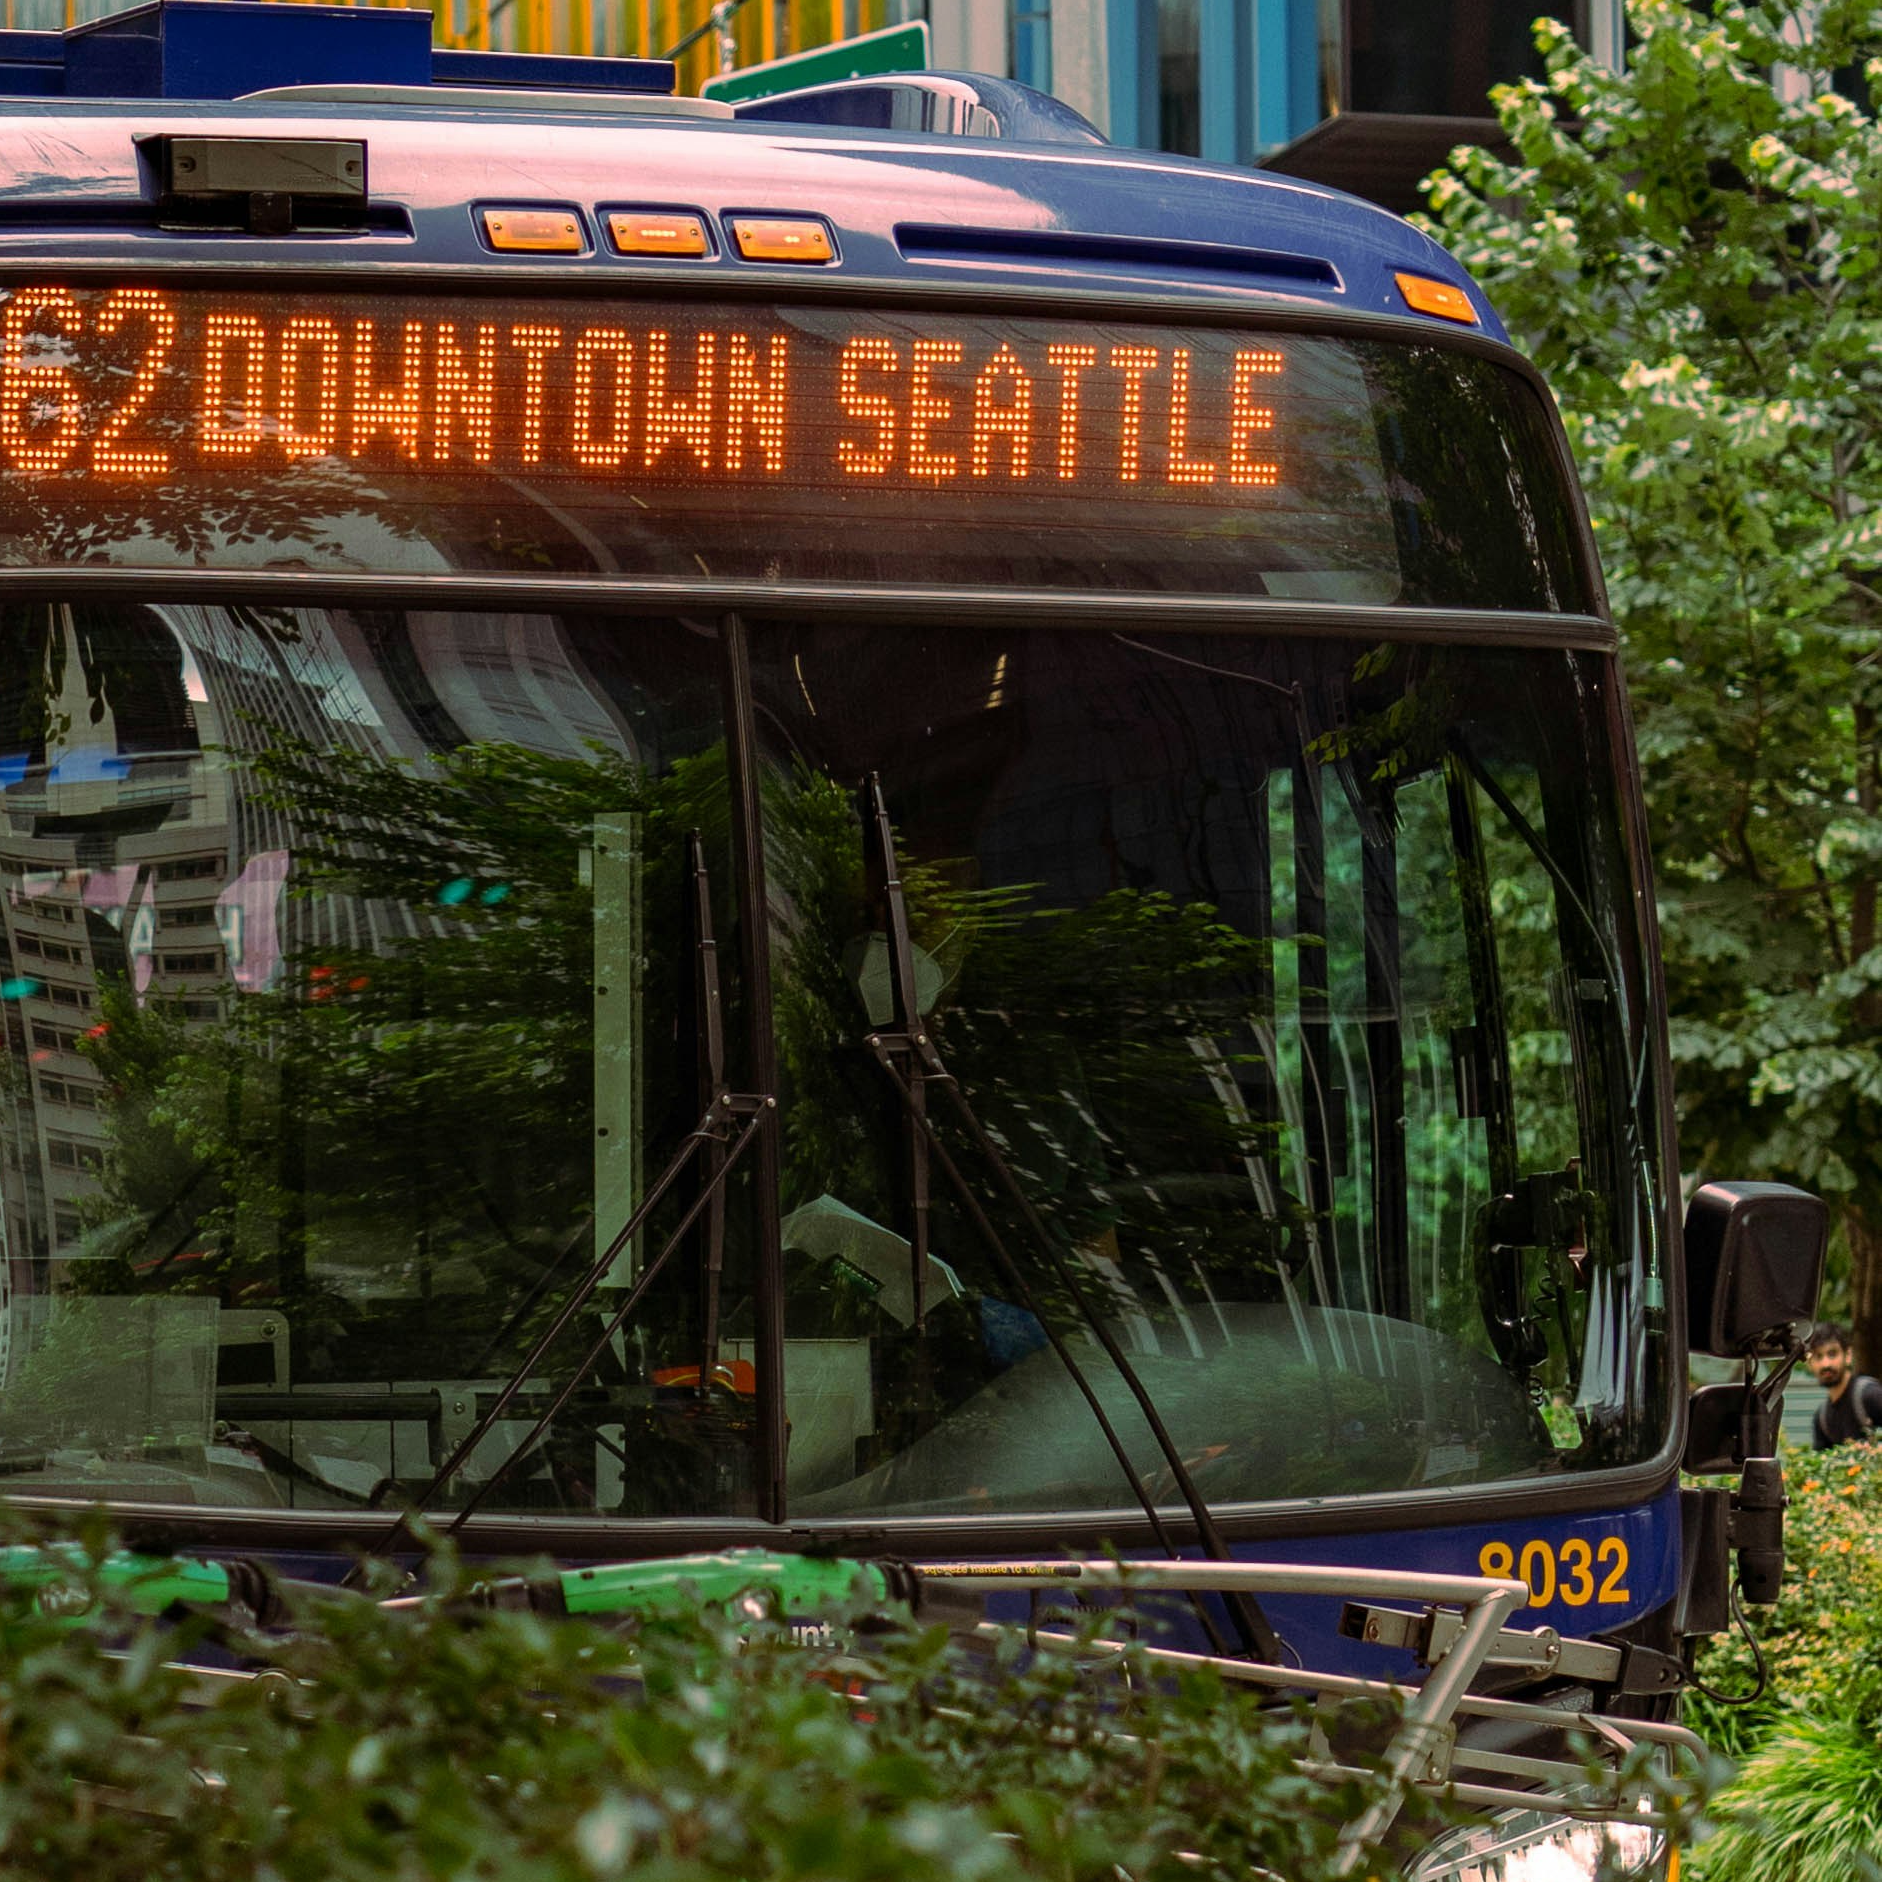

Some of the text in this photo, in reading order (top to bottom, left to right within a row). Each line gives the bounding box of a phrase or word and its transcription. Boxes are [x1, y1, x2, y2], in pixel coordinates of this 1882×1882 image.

[0, 284, 1284, 486] 62 DOWNTOWN SEATTLE
[1478, 1536, 1631, 1609] 8032
